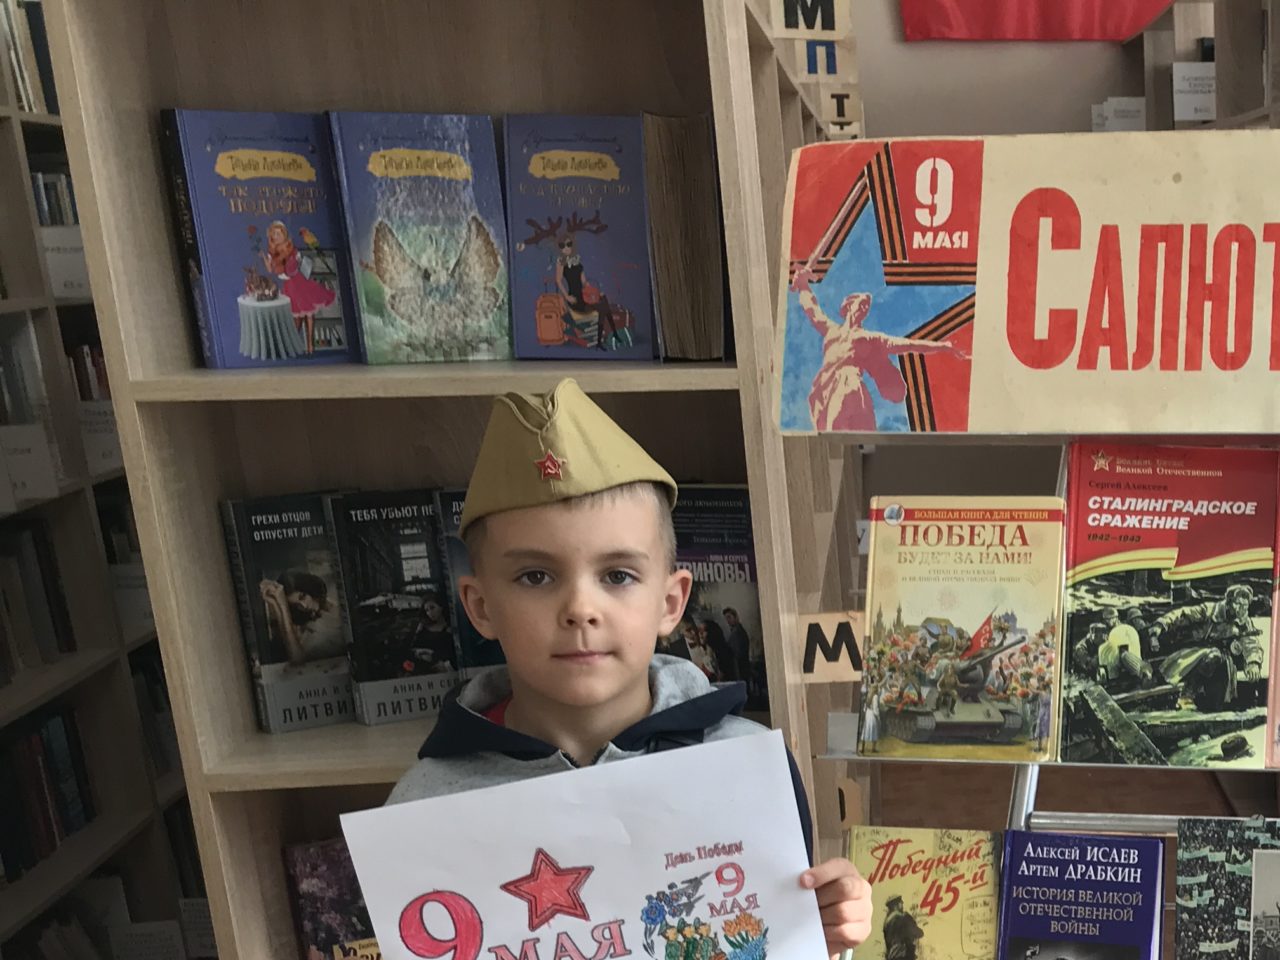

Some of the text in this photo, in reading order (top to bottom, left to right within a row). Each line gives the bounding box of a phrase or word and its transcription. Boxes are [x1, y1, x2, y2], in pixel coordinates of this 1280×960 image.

[806, 40, 837, 74] П
[915, 157, 953, 227] 9
[913, 231, 968, 250] МАЯ
[350, 508, 378, 522] ТЕБЯ
[380, 505, 418, 520] УБЬЮТ
[914, 511, 1049, 520] БОЛЬШАЯ КНИГА ДЛЯ ЧТЕНИЯ
[1088, 496, 1257, 516] СТАЛИНГРАДСКОЕ
[1087, 513, 1191, 530] СРАЖЕНИЕ
[898, 523, 1030, 551] ПОБЕДА
[897, 551, 1032, 566] БУДЕТ ЗА НАМИ!
[803, 622, 863, 673] М
[393, 682, 422, 694] АННА
[282, 701, 356, 724] ЛИТВИ
[376, 695, 442, 718] ЛИТВИ
[868, 839, 987, 885] Победный
[1085, 846, 1139, 864] ИСАЕВ
[715, 862, 745, 898] 9
[1064, 864, 1142, 884] ДРАБКИН
[920, 863, 989, 917] 45-й
[1012, 885, 1143, 907] ИСТОРИЯ ВЕЛИКОЙ
[707, 893, 760, 918] МАЯ
[1019, 902, 1134, 923] ОТЕЧЕСТВЕННОЙ
[1050, 919, 1100, 936] ВОЙНЫ
